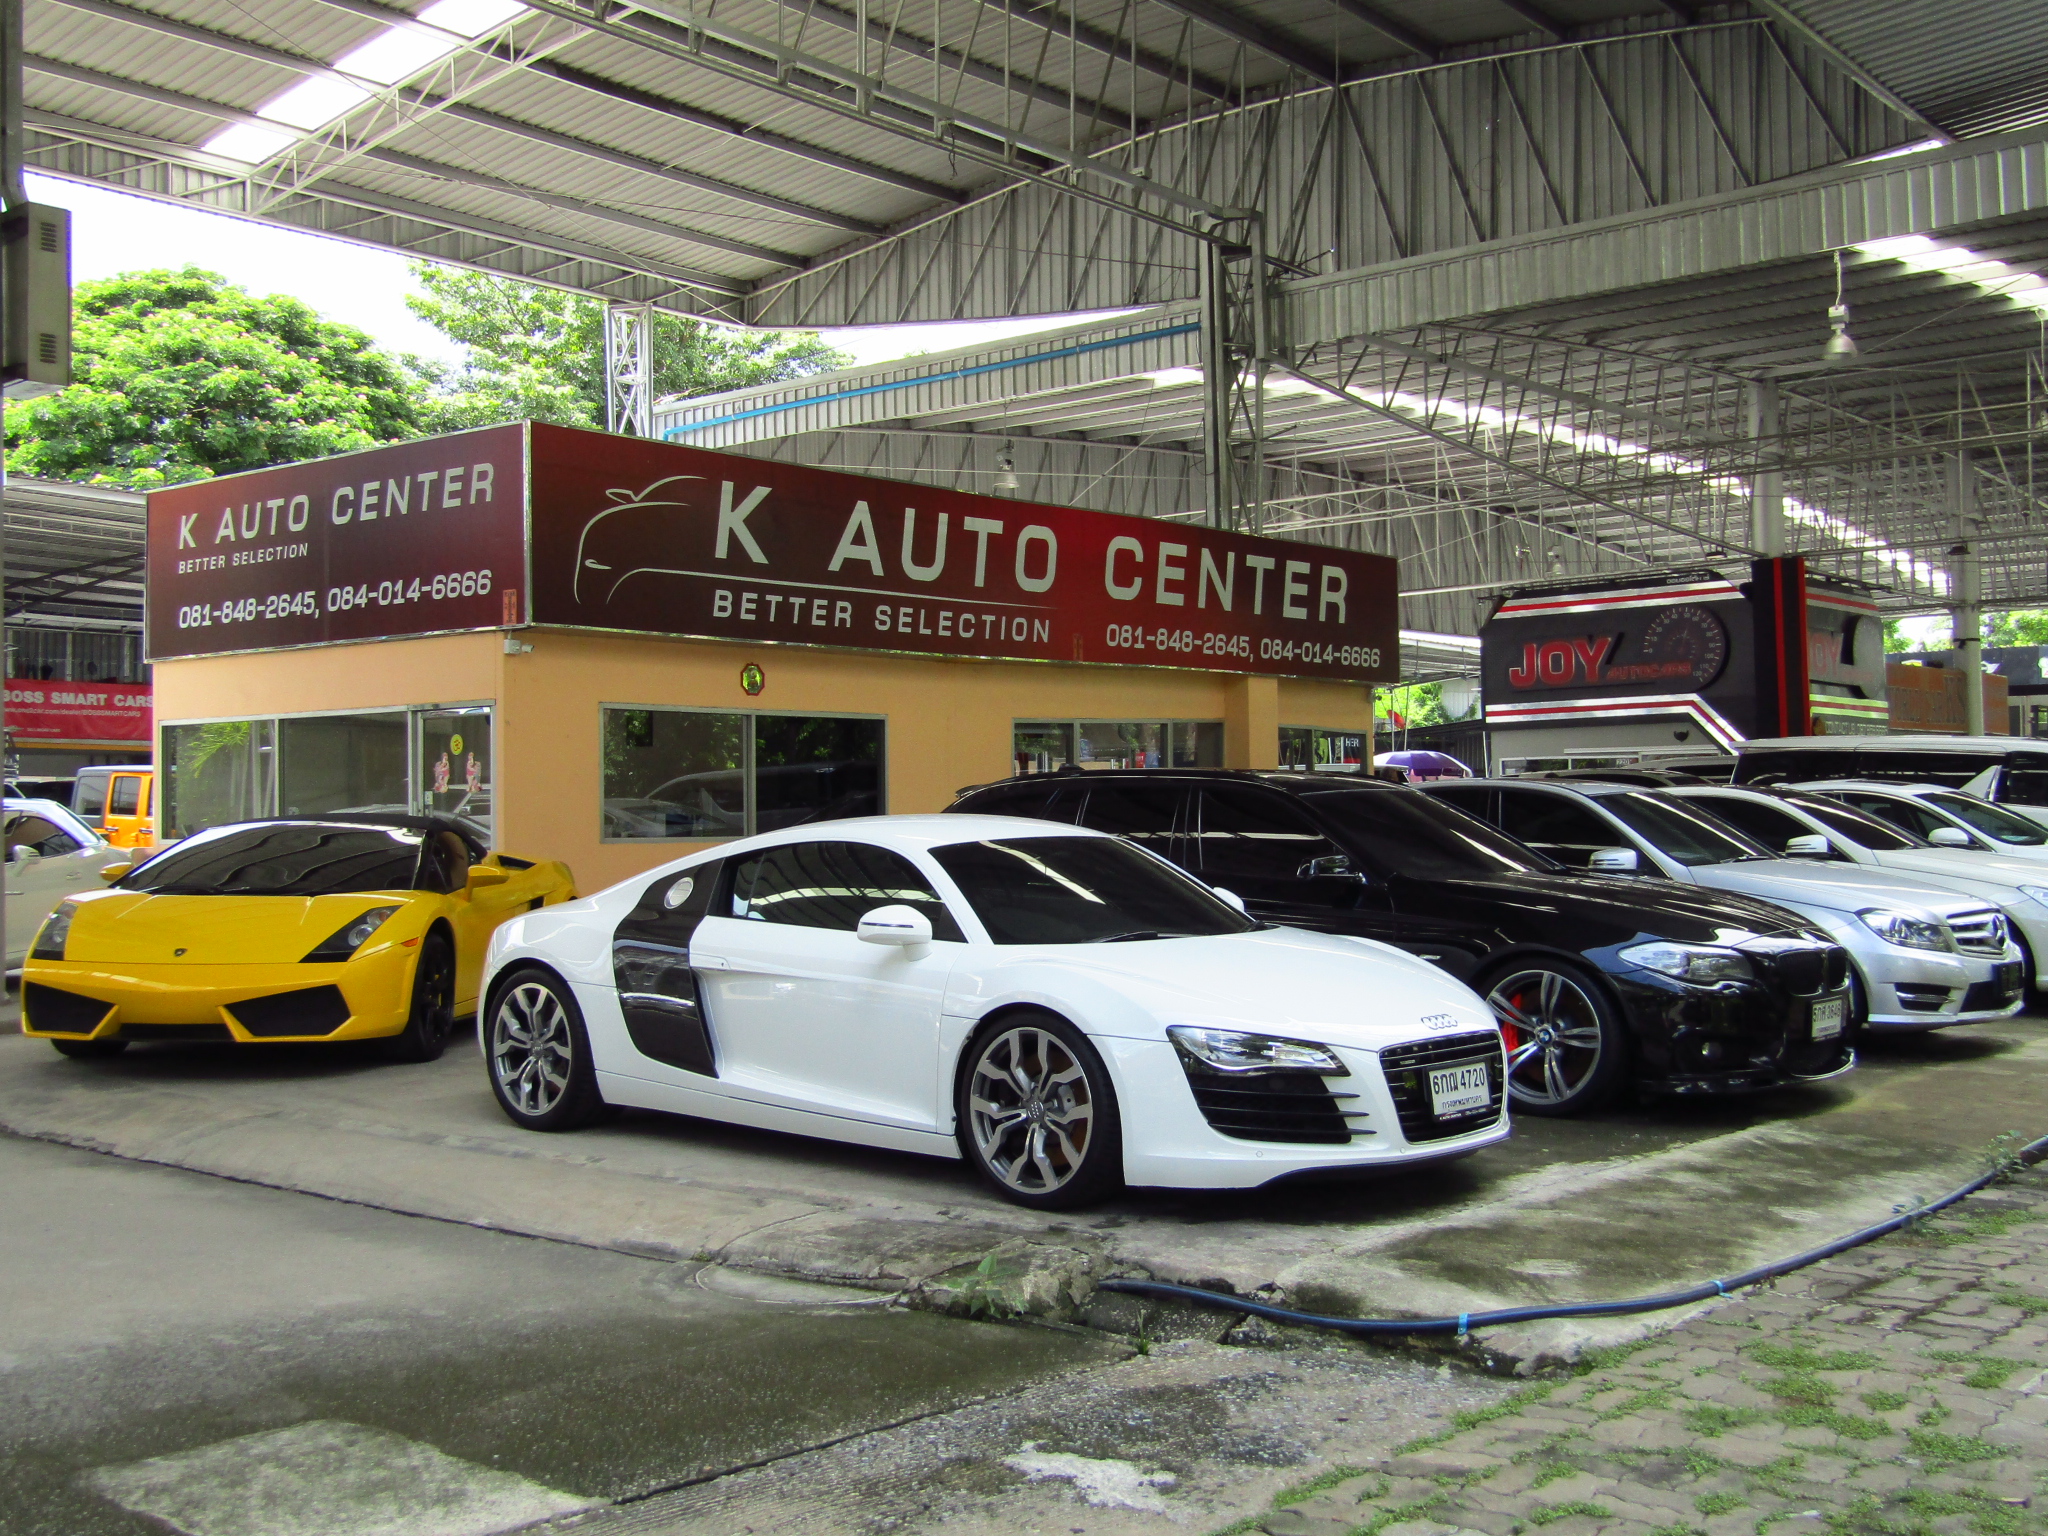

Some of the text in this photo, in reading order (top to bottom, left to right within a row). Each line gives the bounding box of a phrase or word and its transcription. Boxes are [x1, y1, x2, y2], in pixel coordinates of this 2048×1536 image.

[179, 462, 494, 550] K AUTO CENTER
[178, 542, 308, 574] BETTER SELECTION
[714, 480, 1348, 624] K AUTO CENTER
[179, 590, 319, 628] 081-848-2645,
[328, 569, 492, 612] 084-014-6666
[713, 589, 1049, 643] BETTER SELECTION
[1106, 623, 1254, 662] 081-848-2645,
[1260, 638, 1380, 668] 084-014-6666
[1509, 637, 1612, 689] JOY
[51, 692, 108, 706] SMART
[1460, 1067, 1485, 1089] 4720
